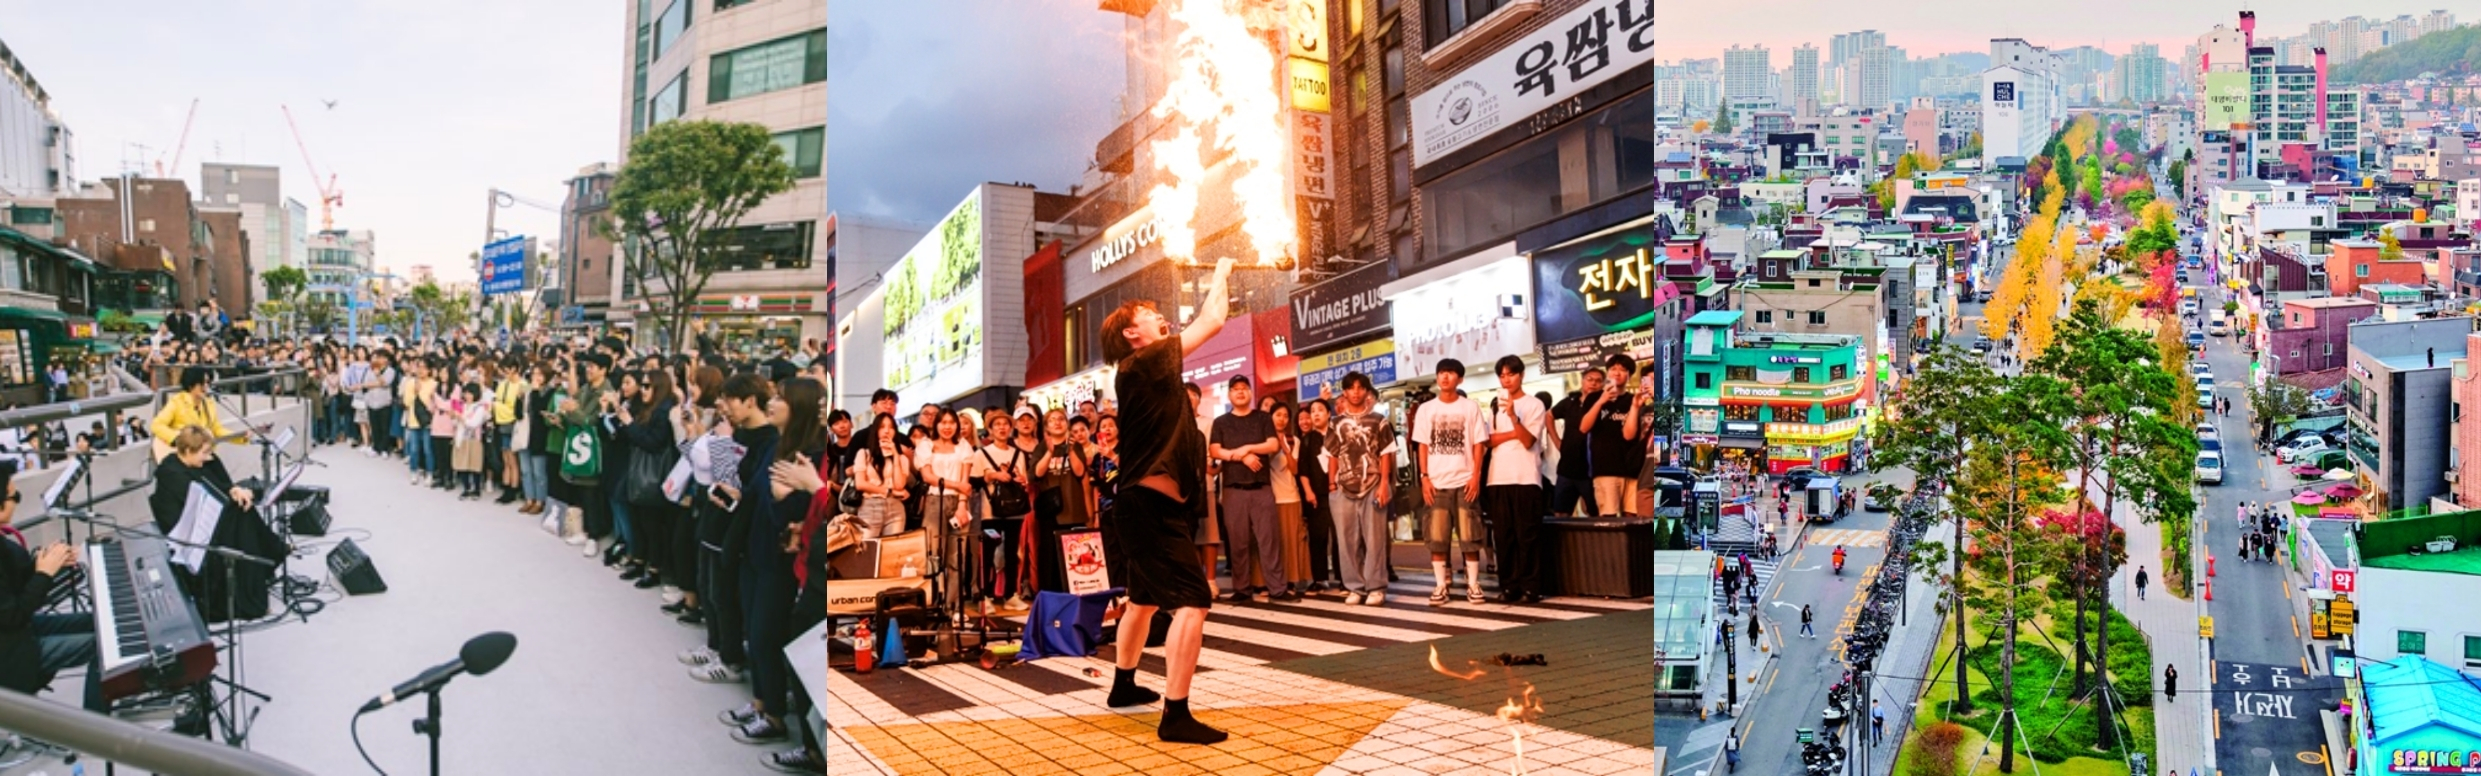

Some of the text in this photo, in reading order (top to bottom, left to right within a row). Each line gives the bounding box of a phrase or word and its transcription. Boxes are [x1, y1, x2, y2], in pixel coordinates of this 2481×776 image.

[1293, 76, 1327, 96] TATTOO
[1478, 95, 1498, 108] SINCE
[1301, 114, 1326, 194] 육쌈냉면
[1308, 201, 1325, 255] VINTAGE
[1091, 229, 1136, 274] HOLLYS
[1579, 248, 1654, 311] 전자
[1295, 294, 1350, 330] VINTAGE
[1352, 286, 1385, 315] PLUS
[568, 431, 593, 465] S
[2335, 573, 2351, 589] 약
[831, 596, 858, 605] urban
[2235, 691, 2297, 719] 자전거
[2393, 749, 2462, 767] SPRING
